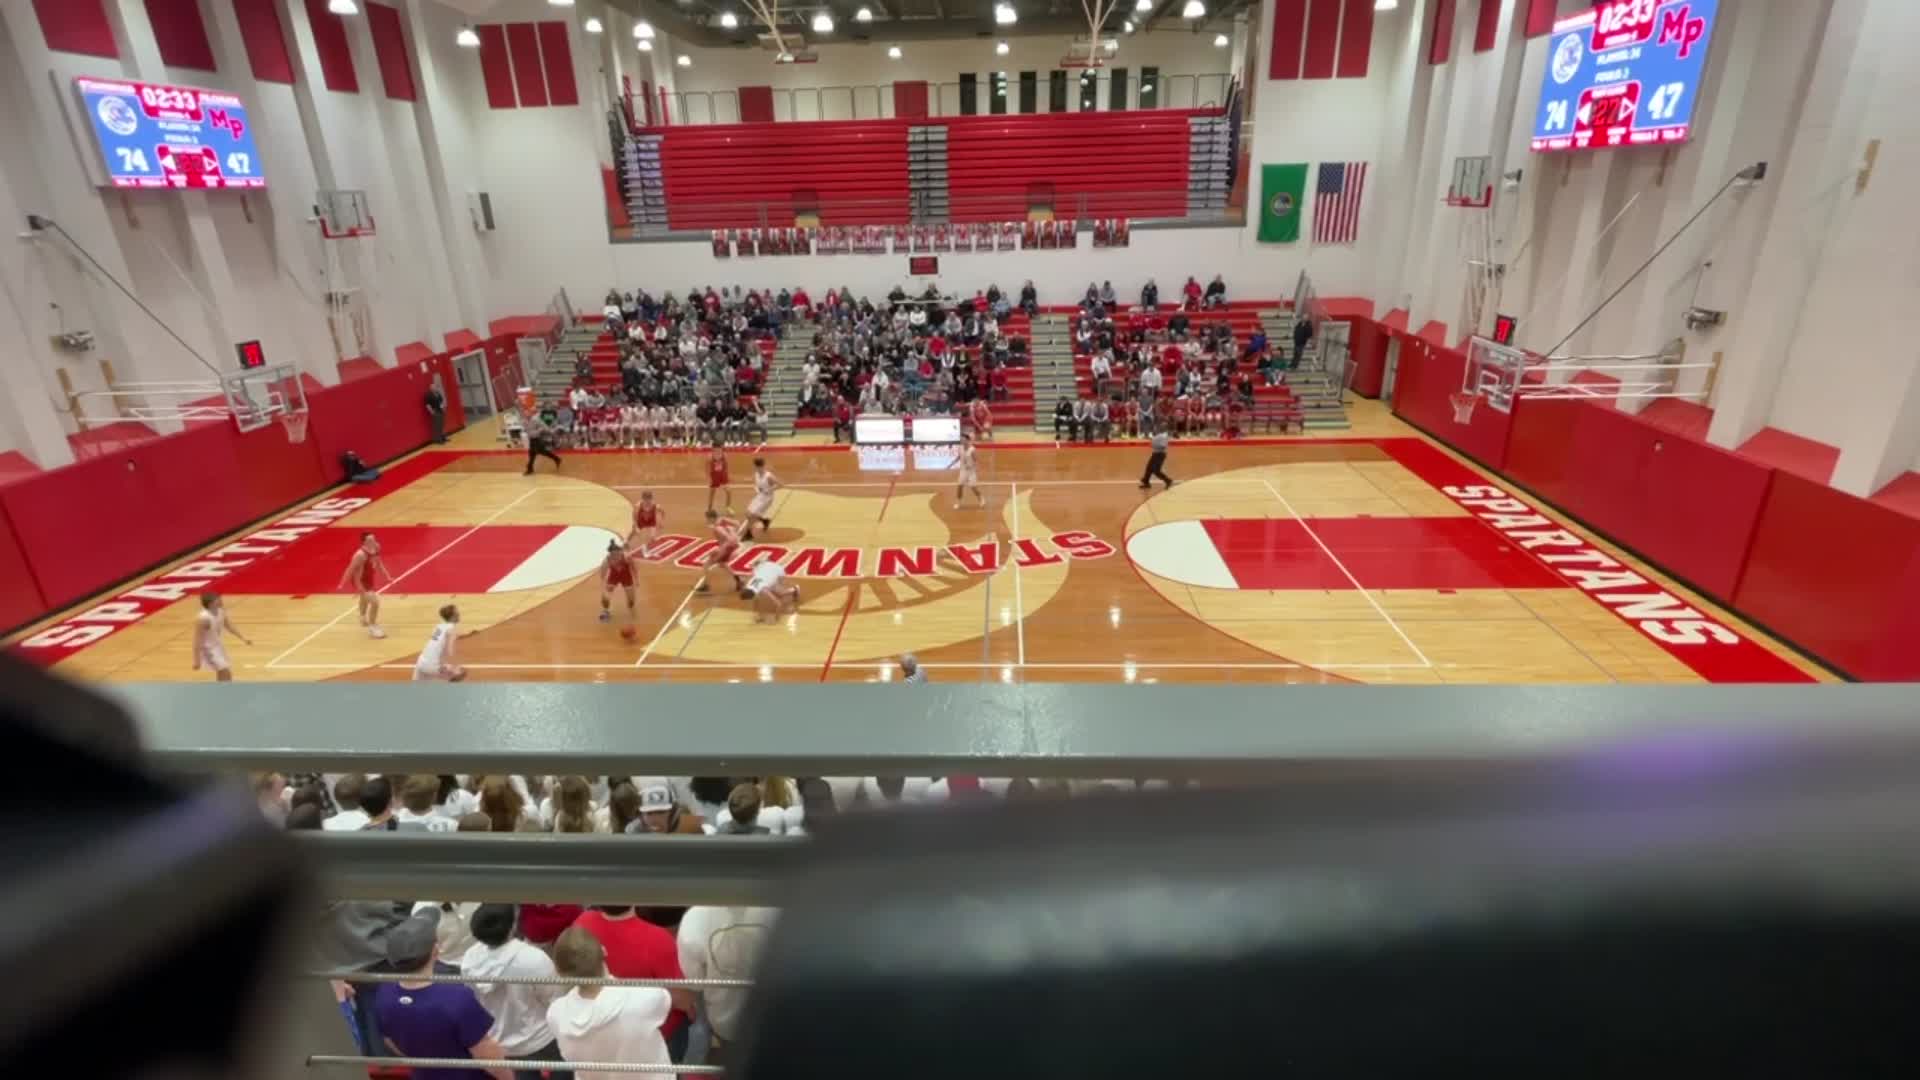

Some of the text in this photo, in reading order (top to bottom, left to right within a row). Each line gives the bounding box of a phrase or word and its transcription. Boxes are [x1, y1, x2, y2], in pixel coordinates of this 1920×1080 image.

[1544, 100, 1567, 130] 74
[1648, 82, 1684, 119] 47
[116, 147, 149, 171] 74
[227, 152, 250, 174] 47
[21, 497, 371, 647] SPARTANS
[1441, 485, 1739, 644] SPARTANS
